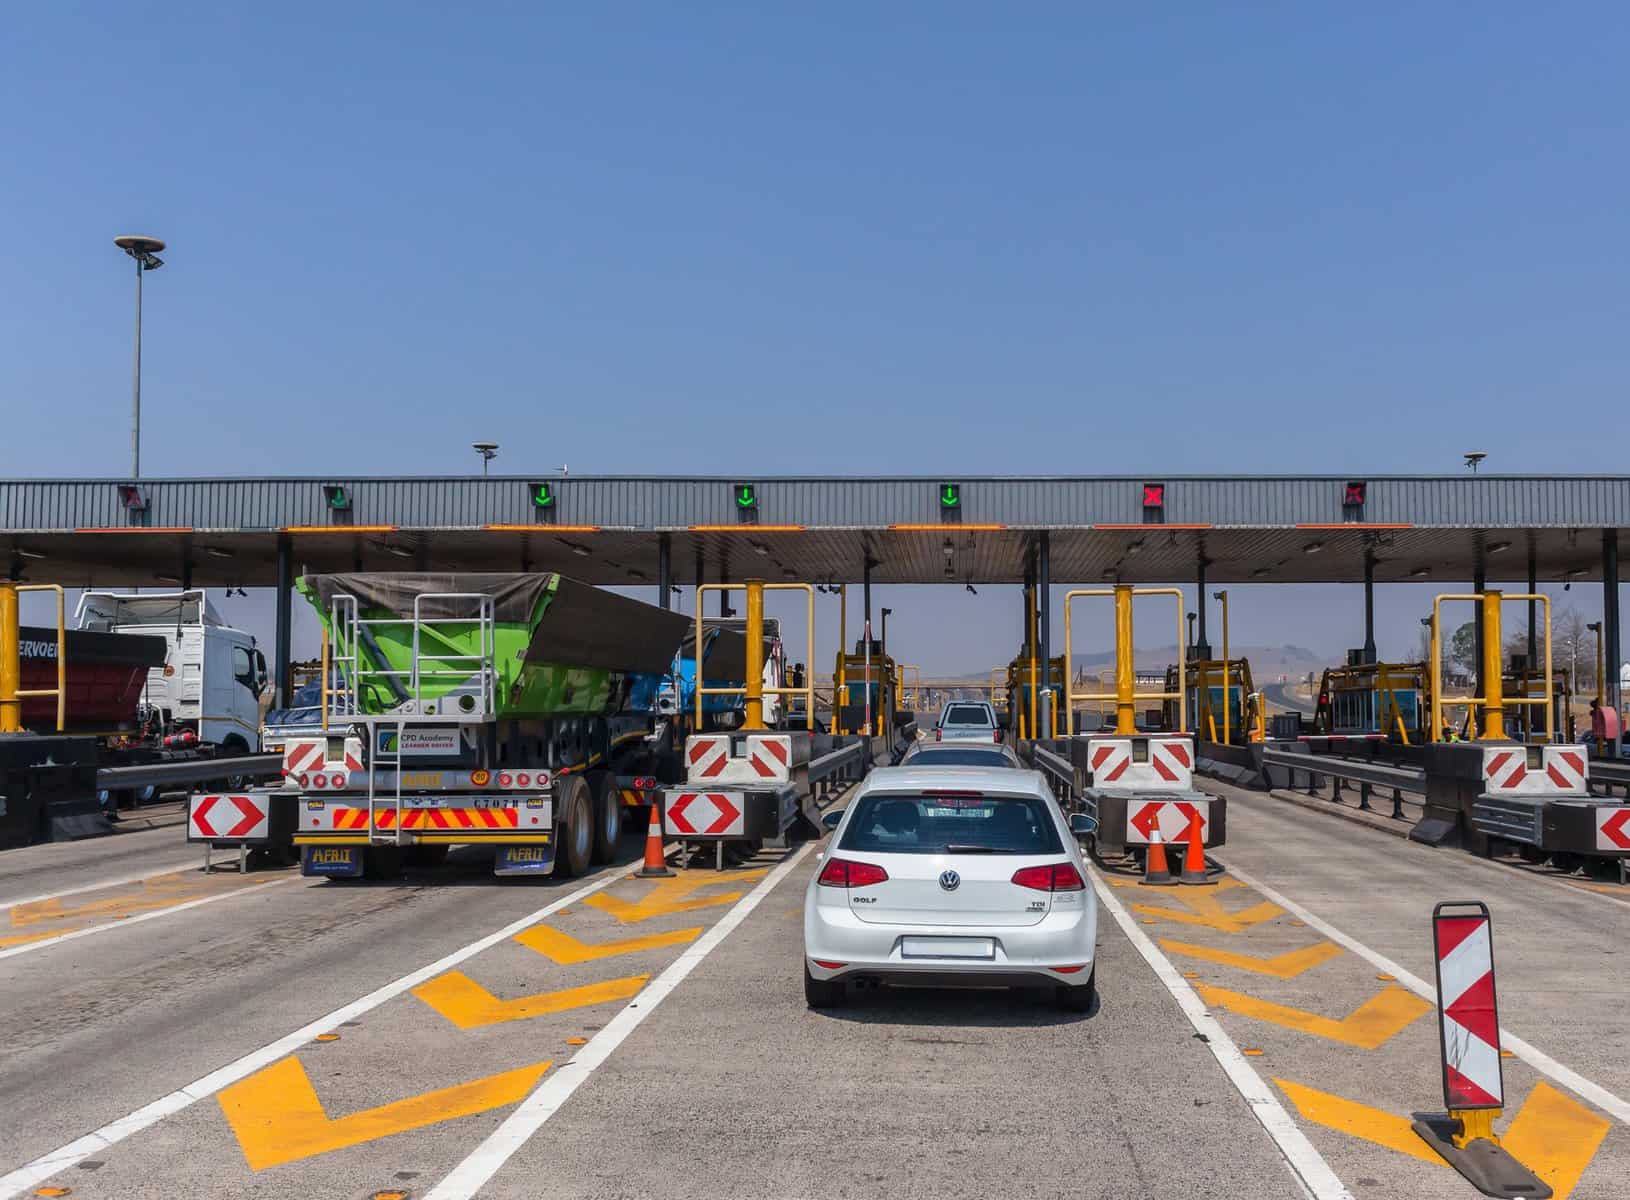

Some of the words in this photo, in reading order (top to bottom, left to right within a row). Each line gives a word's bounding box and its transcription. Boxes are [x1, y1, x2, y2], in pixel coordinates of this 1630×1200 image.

[401, 734, 416, 742] CPD
[419, 734, 454, 742] Academy
[312, 848, 352, 863] AFRIT
[506, 847, 545, 861] AFRIT
[853, 896, 877, 904] GOLF
